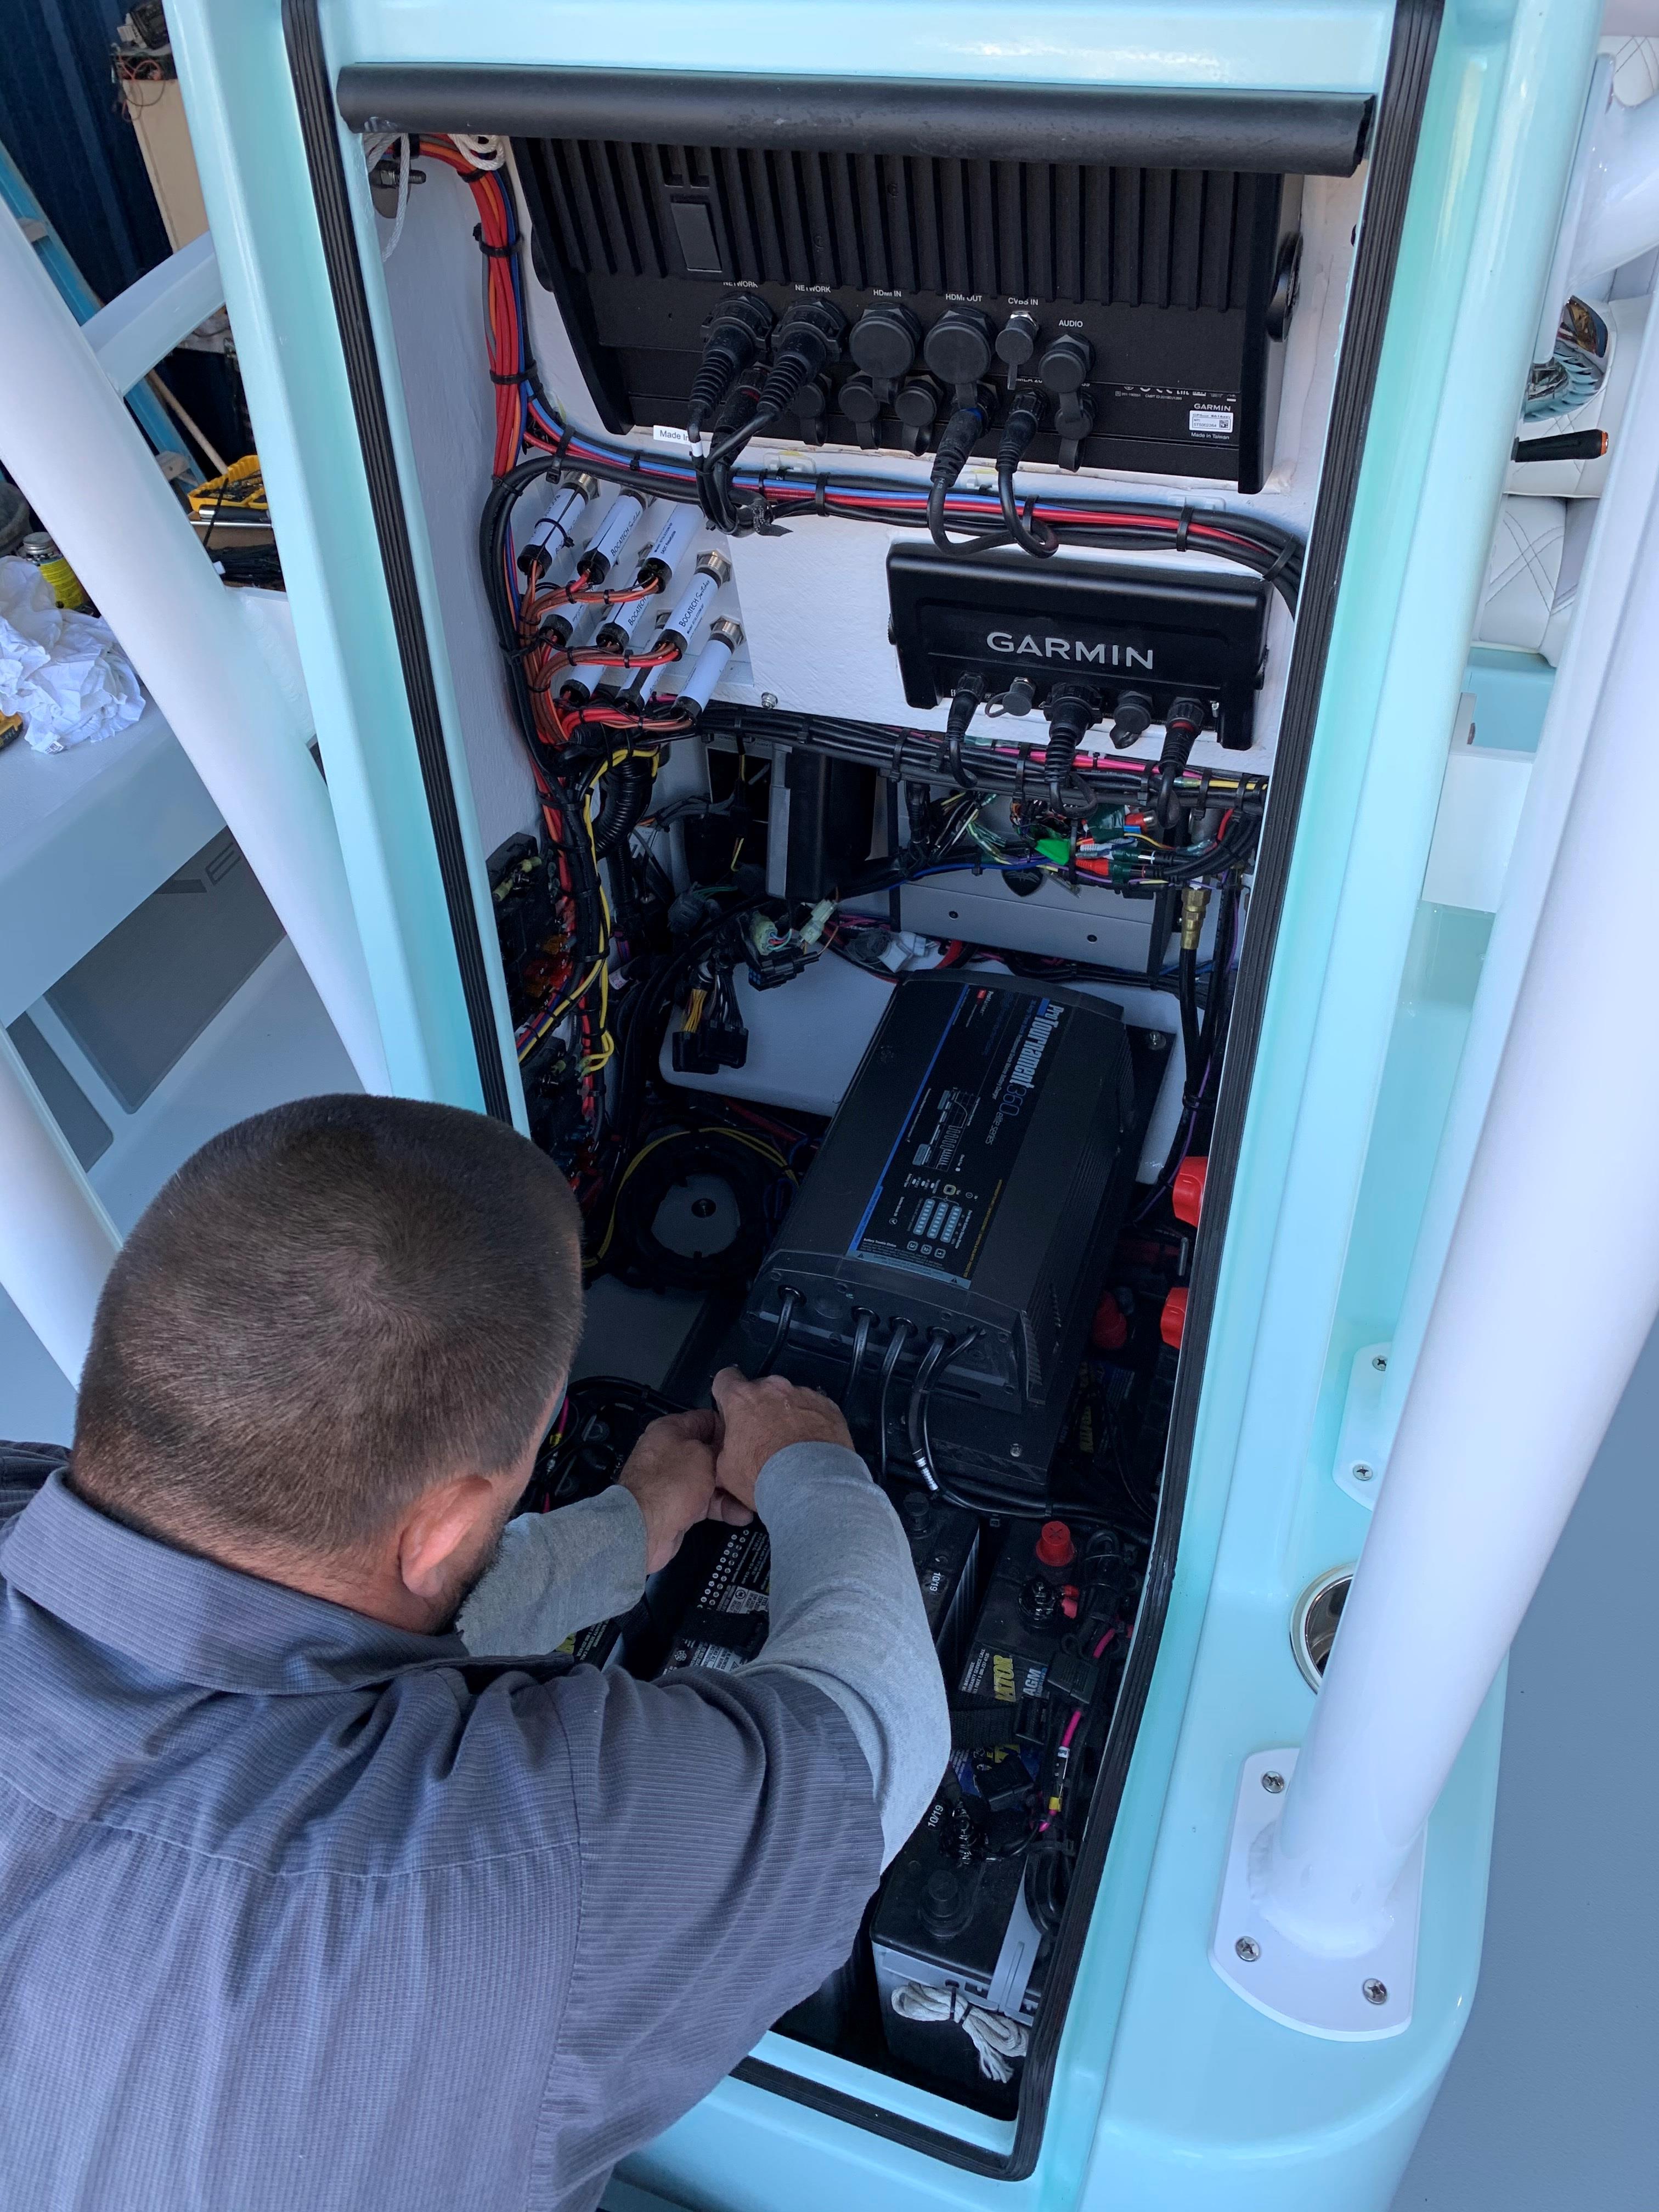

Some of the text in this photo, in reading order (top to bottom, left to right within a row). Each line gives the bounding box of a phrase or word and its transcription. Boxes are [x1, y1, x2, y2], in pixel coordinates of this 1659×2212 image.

[1008, 297, 1029, 305] CVBS
[1058, 319, 1084, 328] AUDIO
[1194, 403, 1231, 411] GARMIN
[660, 430, 681, 439] Made
[610, 527, 630, 557] BOCATECH
[628, 595, 647, 626] BOCATECH
[679, 598, 699, 627] BOCATECH
[696, 580, 710, 601] Switches
[986, 631, 1154, 670] GARMIN
[999, 1084, 1027, 1116] 360
[992, 1111, 1003, 1127] elite
[985, 1125, 997, 1146] series
[929, 1572, 941, 1592] 10/19
[963, 1662, 975, 1686] NATIONWIDE
[973, 1658, 981, 1674] SERVICE
[1023, 1668, 1042, 1696] AGM
[928, 1804, 944, 1827] 10/19
